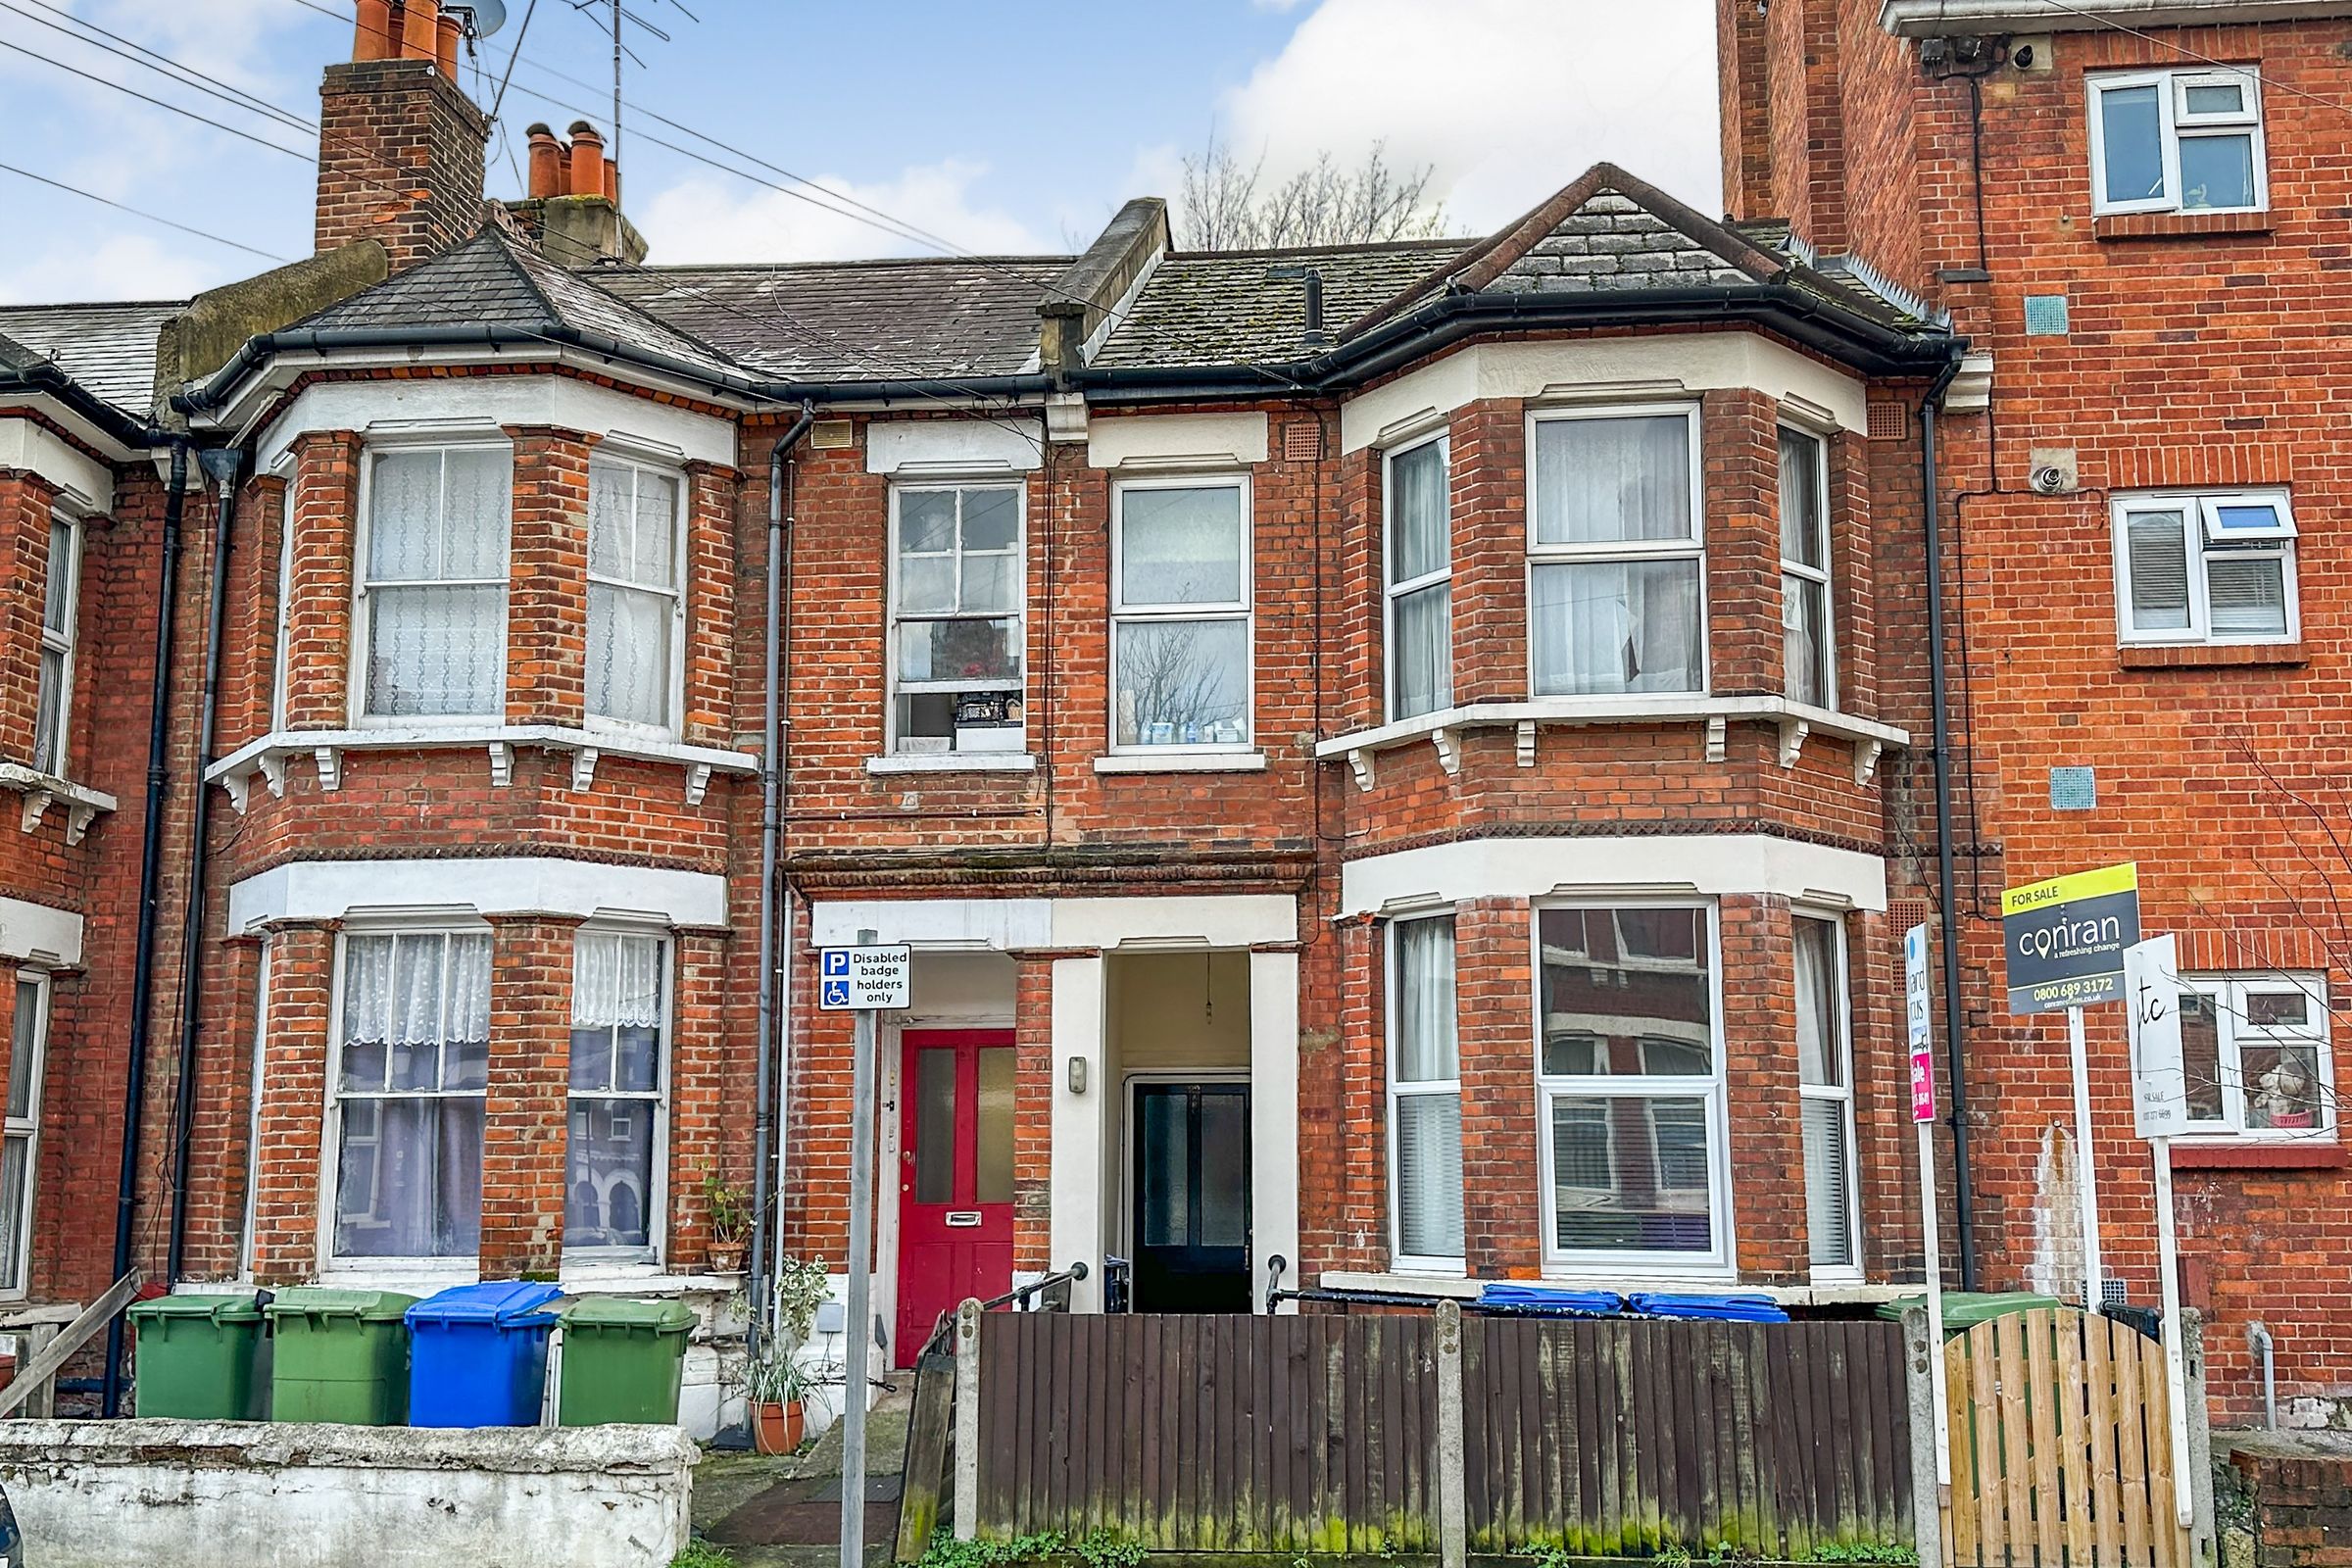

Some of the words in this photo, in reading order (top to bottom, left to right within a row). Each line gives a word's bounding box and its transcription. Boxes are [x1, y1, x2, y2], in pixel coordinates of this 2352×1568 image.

[2012, 893, 2032, 906] FOR
[2034, 886, 2058, 902] SALE
[2019, 916, 2120, 959] conran
[854, 953, 906, 963] Disabled
[2059, 946, 2093, 958] refreshing
[2093, 942, 2120, 954] change
[830, 954, 846, 974] P
[861, 965, 899, 976] badge
[858, 980, 903, 990] holders
[2034, 986, 2058, 1002] 0800
[2061, 982, 2081, 997] 689
[2083, 978, 2114, 994] 3172
[867, 992, 893, 1003] only
